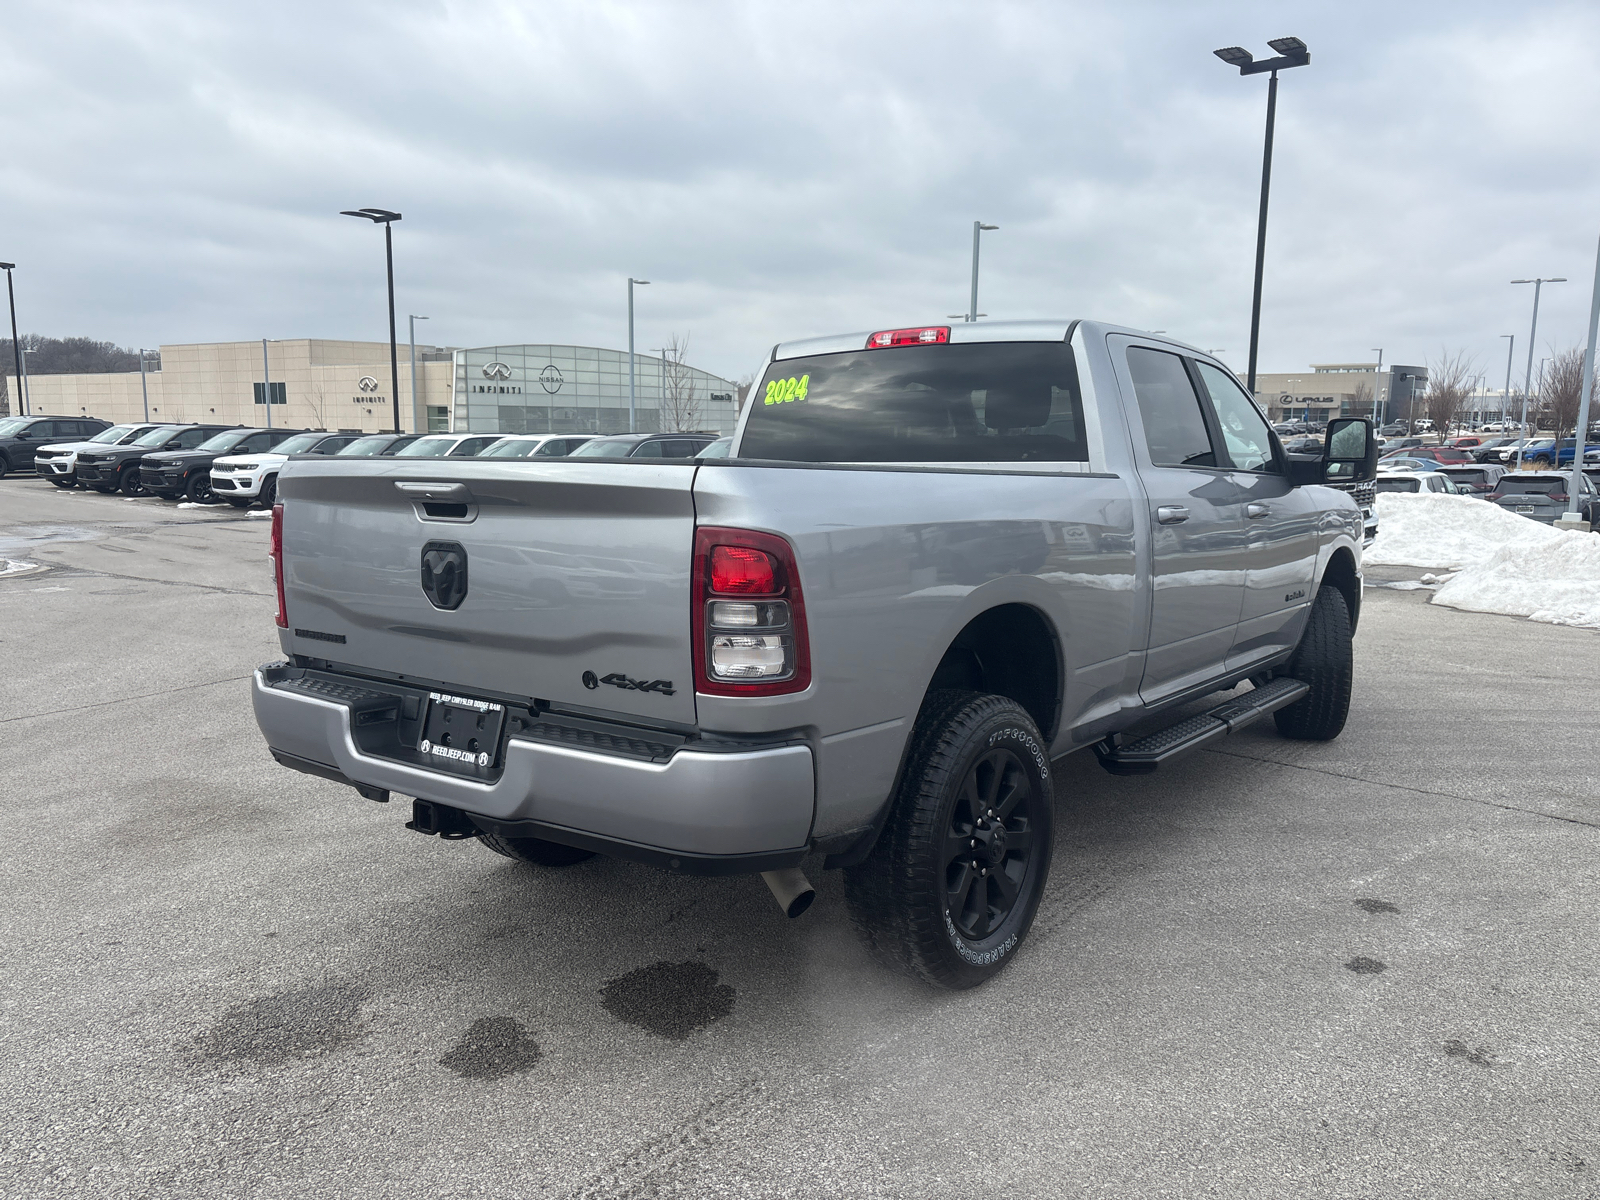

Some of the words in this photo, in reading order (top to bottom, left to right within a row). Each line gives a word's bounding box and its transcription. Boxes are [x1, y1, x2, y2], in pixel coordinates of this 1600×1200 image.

[473, 385, 522, 394] INFINITI
[764, 374, 810, 405] 2024
[352, 396, 386, 404] INFINITI
[430, 692, 440, 700] REED
[441, 694, 452, 702] JEEP
[452, 696, 473, 706] CHRYSLER
[474, 700, 489, 710] DODGE
[489, 703, 500, 711] RAM
[955, 933, 1018, 965] TRANSFORCE
